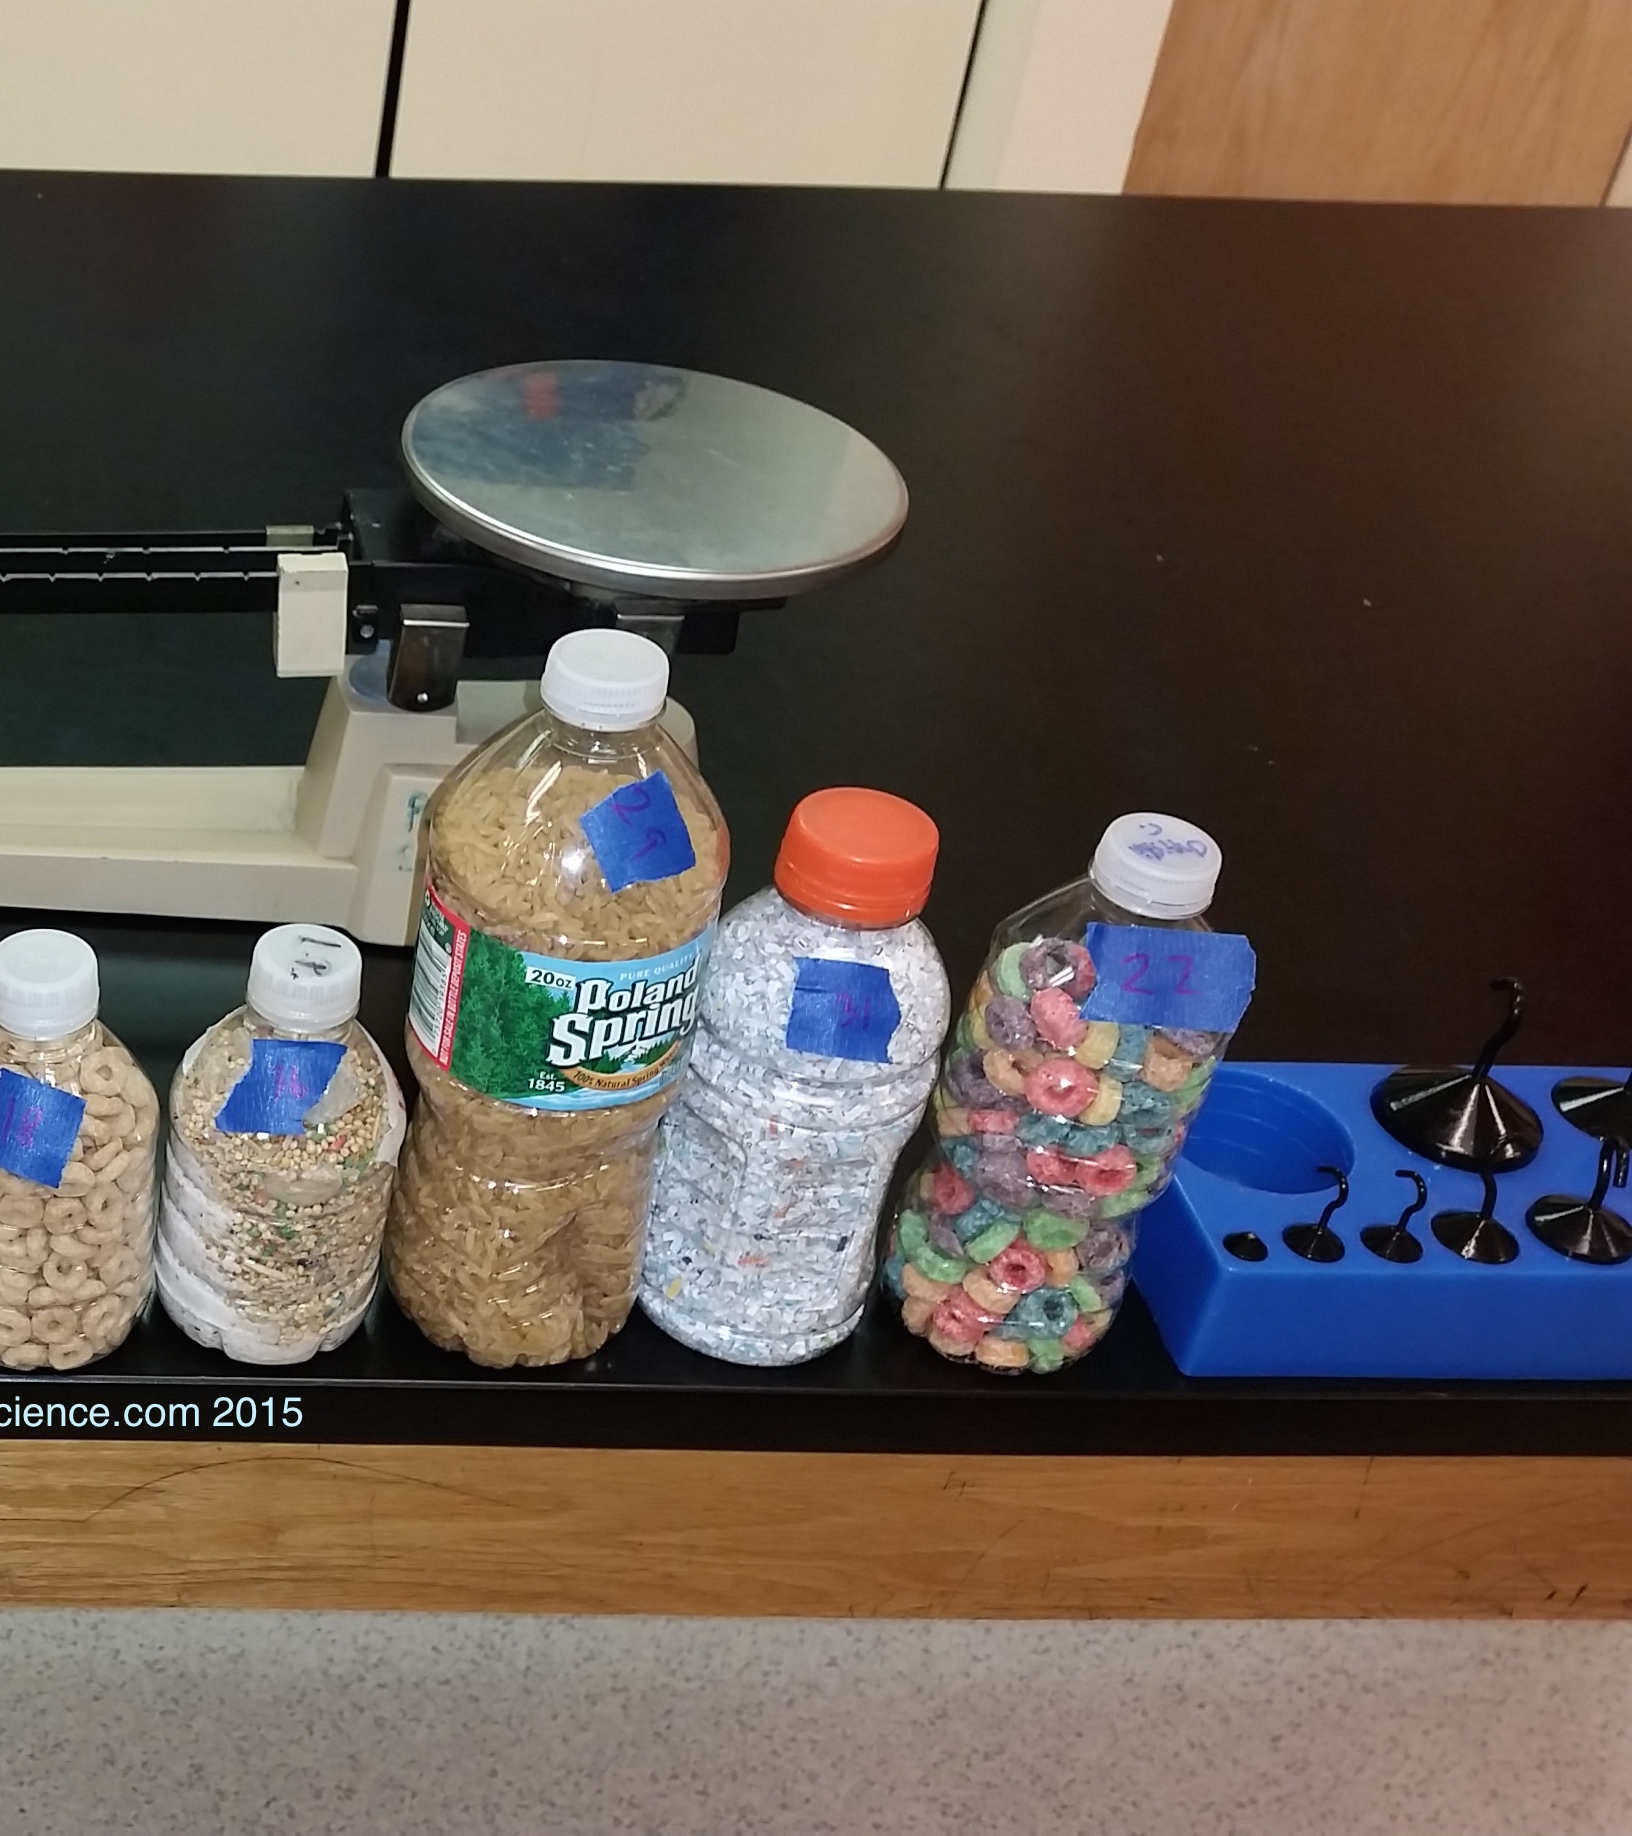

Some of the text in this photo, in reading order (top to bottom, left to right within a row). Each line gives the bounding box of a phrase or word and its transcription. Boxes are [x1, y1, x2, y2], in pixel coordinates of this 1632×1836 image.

[455, 930, 467, 959] STATES
[450, 956, 463, 986] DEPOSIT
[576, 953, 701, 1014] Poland
[620, 968, 650, 981] PURE
[447, 983, 459, 1013] BOTTLE
[546, 984, 700, 1066] Spring
[528, 1078, 566, 1092] 1845
[539, 1071, 557, 1081] Est.
[573, 1071, 593, 1086] 100%
[595, 1078, 630, 1089] Natural
[631, 1068, 659, 1086] Spring
[0, 1095, 45, 1150] 18
